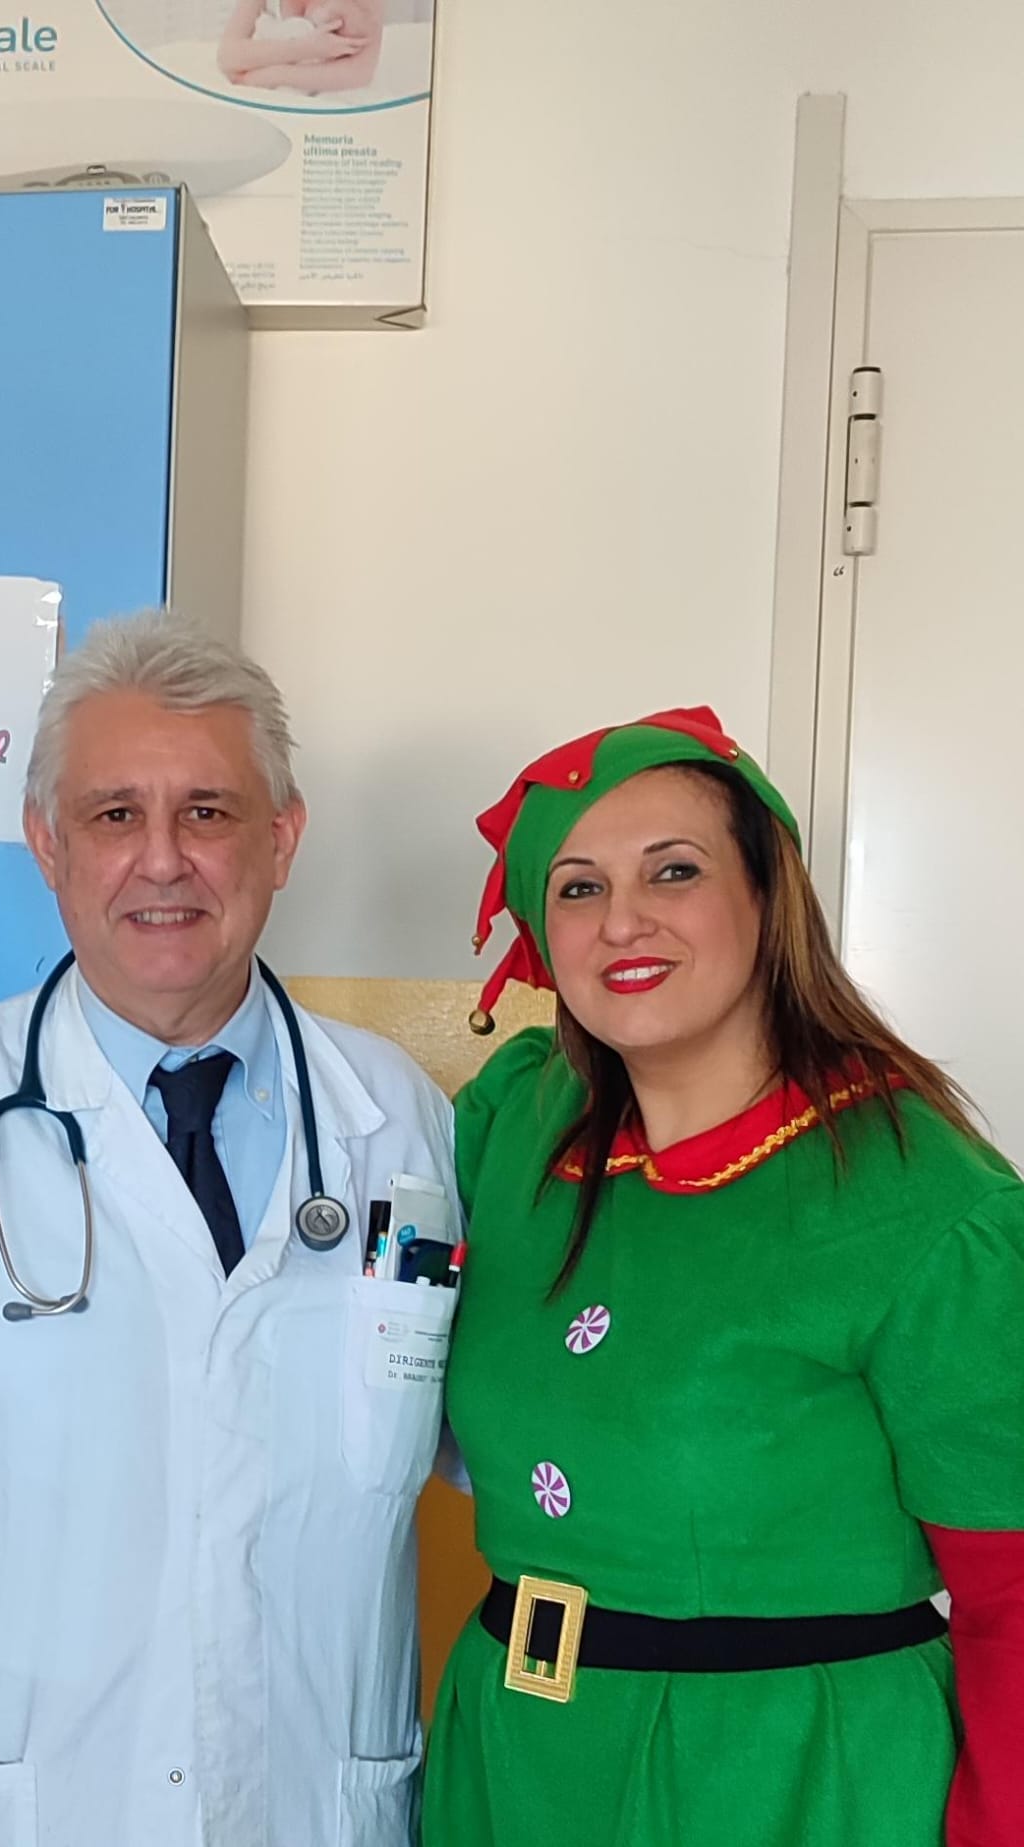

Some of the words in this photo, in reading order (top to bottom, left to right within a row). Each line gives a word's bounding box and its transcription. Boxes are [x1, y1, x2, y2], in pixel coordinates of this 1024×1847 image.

[14, 60, 56, 72] SCALE
[304, 134, 353, 145] Memoria
[303, 146, 338, 156] ultima
[341, 147, 377, 158] pesata
